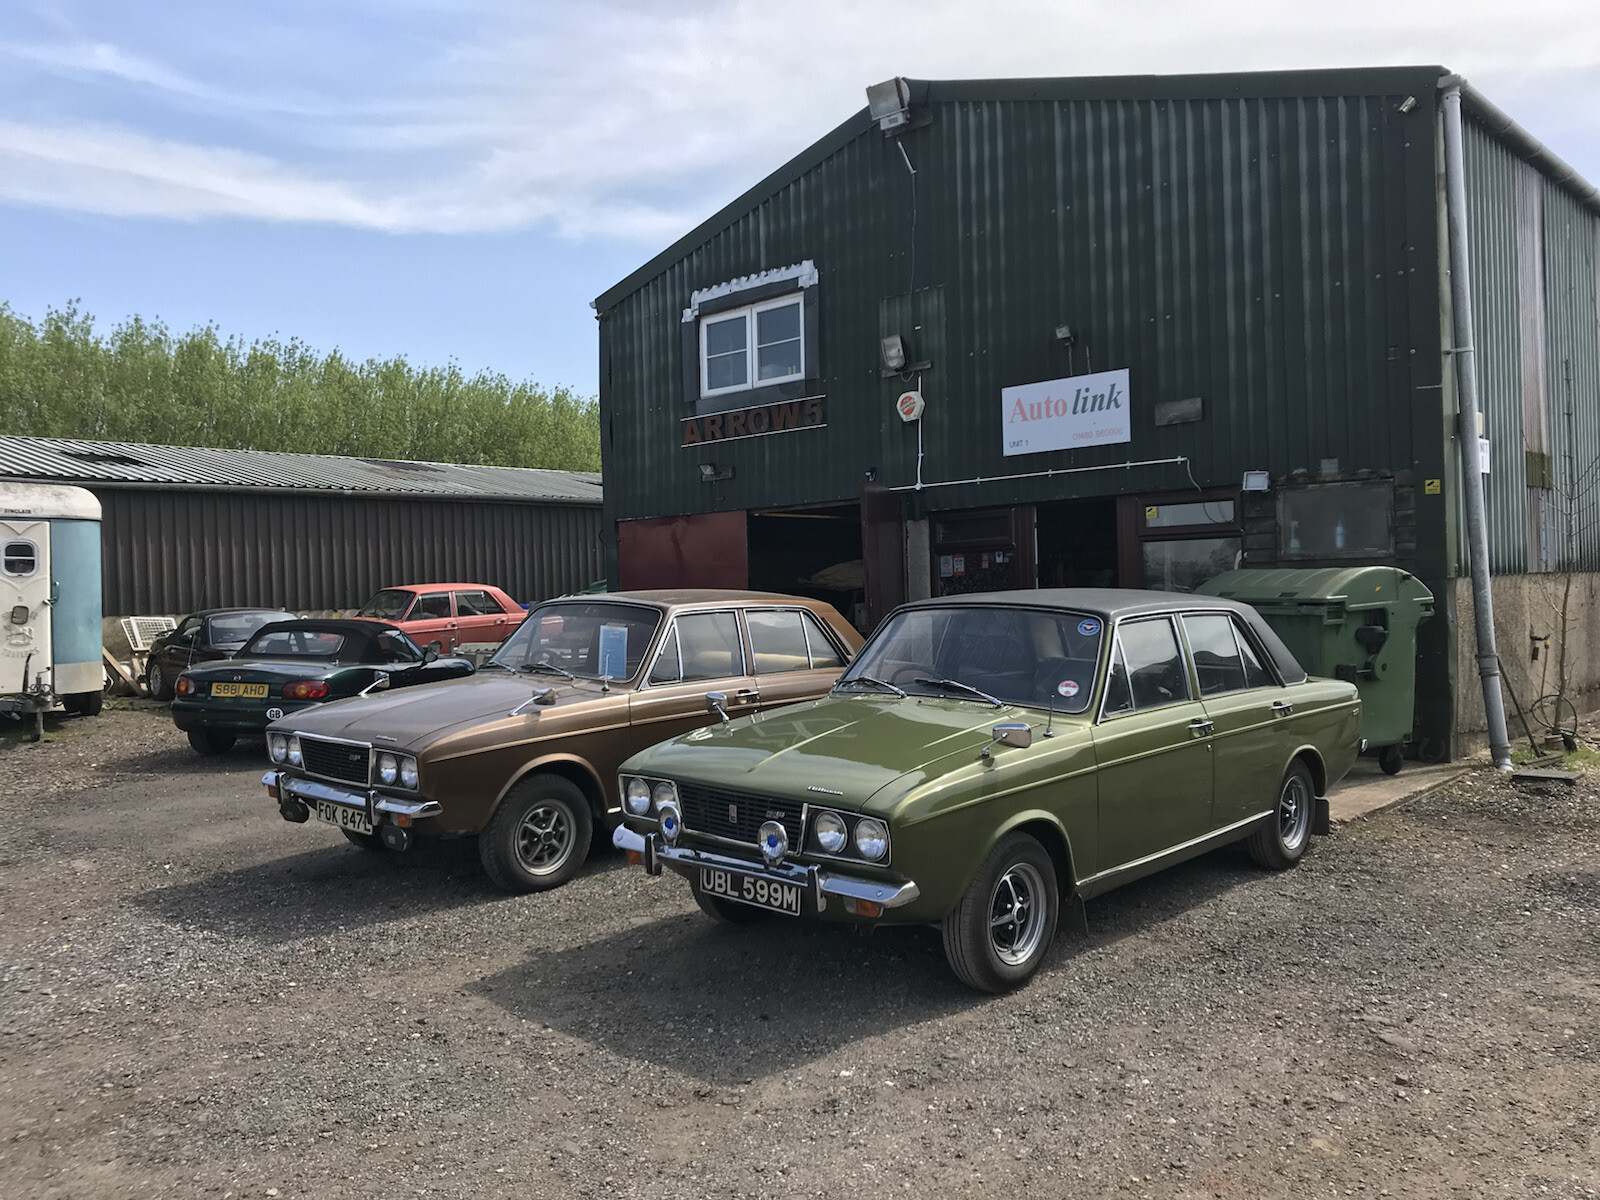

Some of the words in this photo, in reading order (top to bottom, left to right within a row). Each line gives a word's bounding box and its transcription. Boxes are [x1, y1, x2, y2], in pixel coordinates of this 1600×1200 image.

[1010, 395, 1068, 423] Auto
[1072, 383, 1123, 415] link
[683, 402, 800, 444] ARROW
[804, 400, 823, 425] 5
[1009, 440, 1024, 449] UNIT
[1073, 431, 1093, 441] 01489
[215, 684, 240, 696] S881
[242, 684, 266, 696] AHO
[269, 709, 281, 719] GB
[318, 802, 339, 824] FOK
[341, 809, 371, 833] 847L
[703, 868, 739, 898] UBL
[743, 876, 797, 911] 599M
